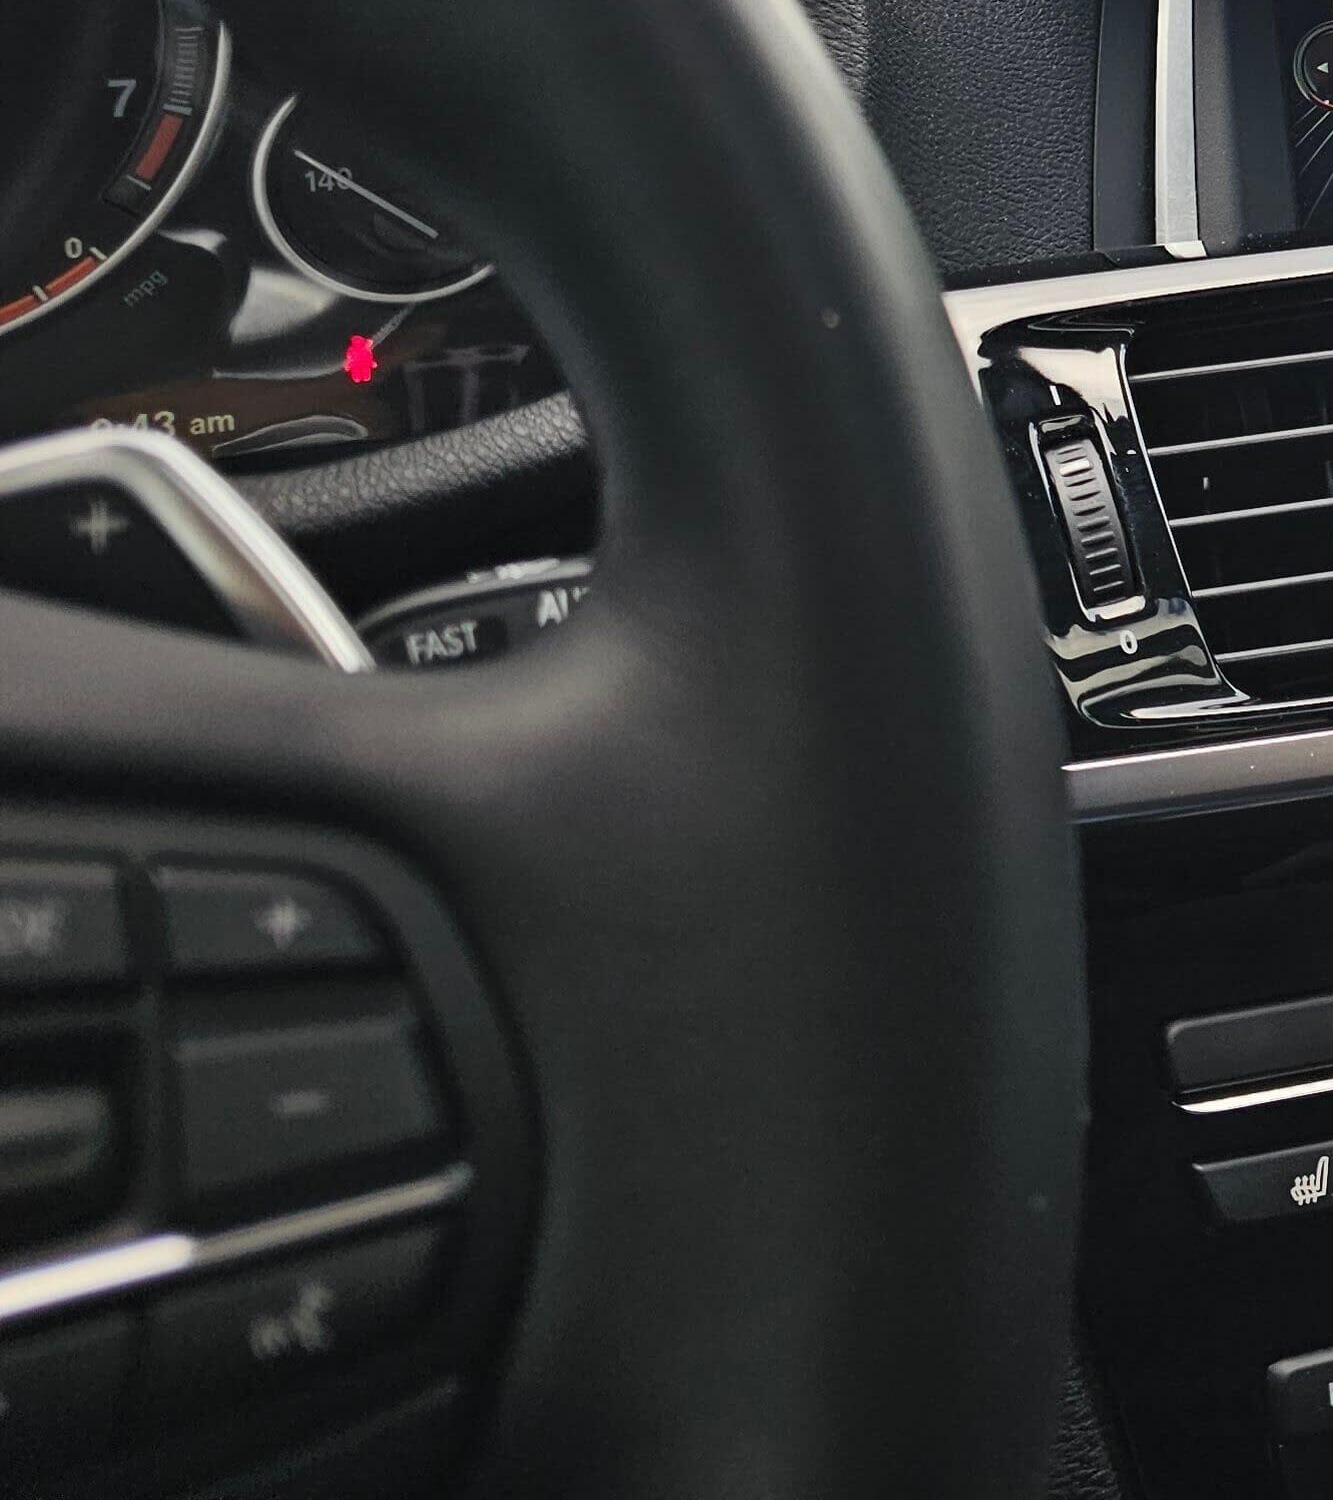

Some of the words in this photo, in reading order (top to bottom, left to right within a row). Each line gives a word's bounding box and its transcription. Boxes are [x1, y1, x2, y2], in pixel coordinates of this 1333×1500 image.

[107, 79, 137, 118] 7
[305, 167, 352, 192] 140
[64, 237, 83, 259] 0
[123, 269, 169, 308] mpg
[190, 413, 235, 435] am
[404, 620, 478, 665] FAST
